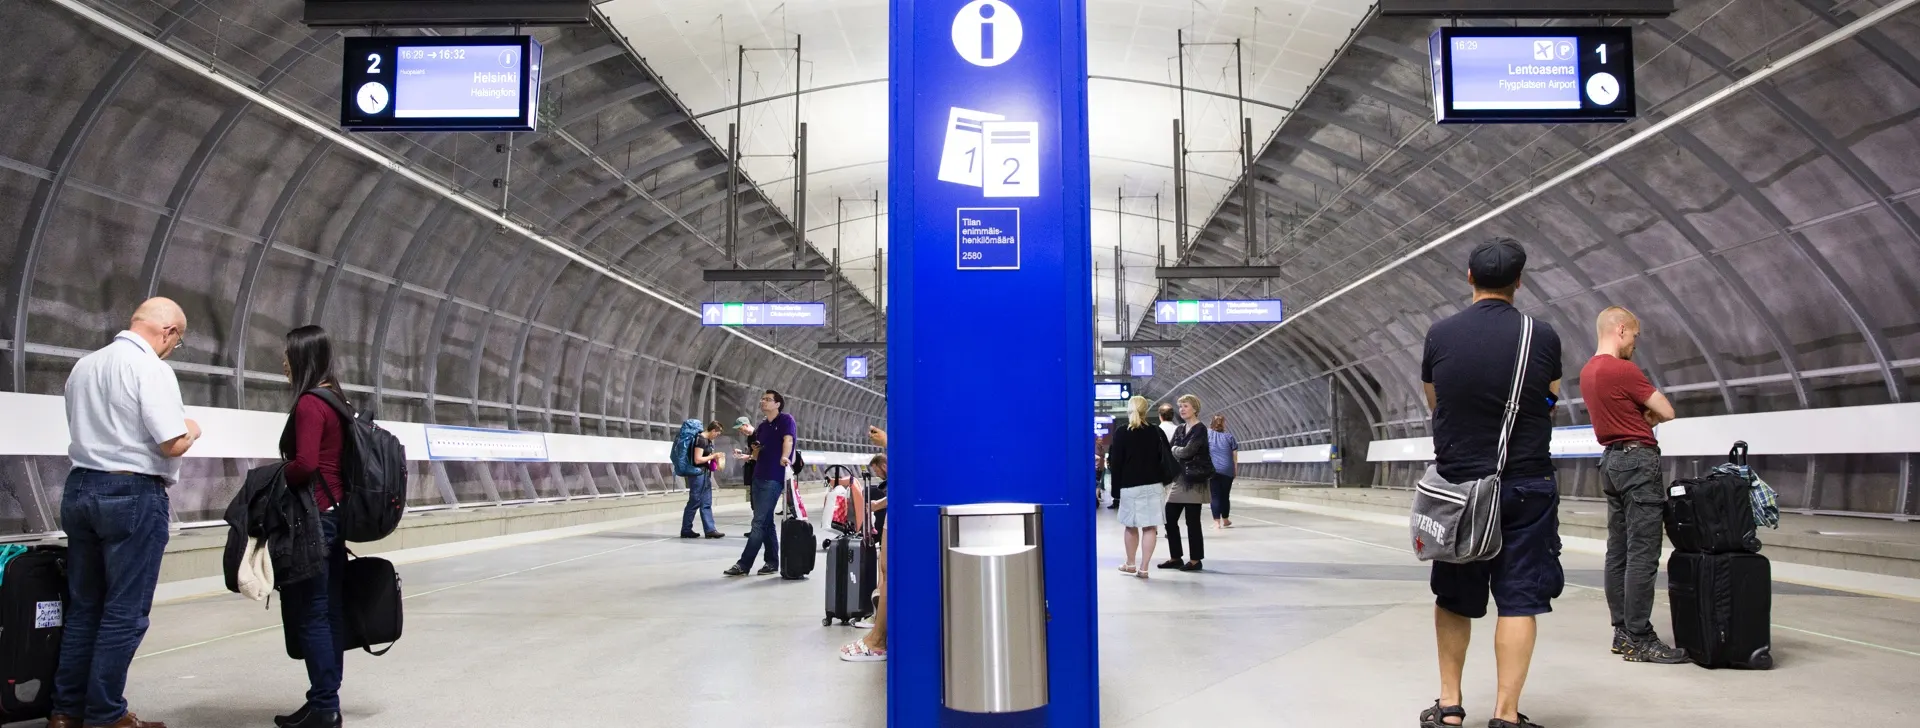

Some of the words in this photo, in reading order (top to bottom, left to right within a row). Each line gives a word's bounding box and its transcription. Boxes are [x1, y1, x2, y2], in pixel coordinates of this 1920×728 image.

[1455, 40, 1478, 50] 16:29
[401, 49, 424, 60] 16:29
[439, 49, 465, 60] 16:32
[1595, 43, 1607, 64] 1
[367, 53, 381, 74] 2
[1508, 64, 1575, 75] Lentoasema
[473, 71, 517, 83] Helsinki
[1499, 79, 1546, 91] Flygplatsen
[1548, 79, 1576, 90] Airport
[471, 87, 516, 99] Helsingfors
[964, 147, 977, 173] 1
[1002, 157, 1021, 185] 2
[962, 218, 982, 226] Tilan
[962, 227, 1003, 235] enimmäis-
[962, 236, 1015, 244] henkilömäärä
[962, 252, 983, 260] 2580
[850, 360, 862, 375] 2
[1138, 360, 1146, 373] 1
